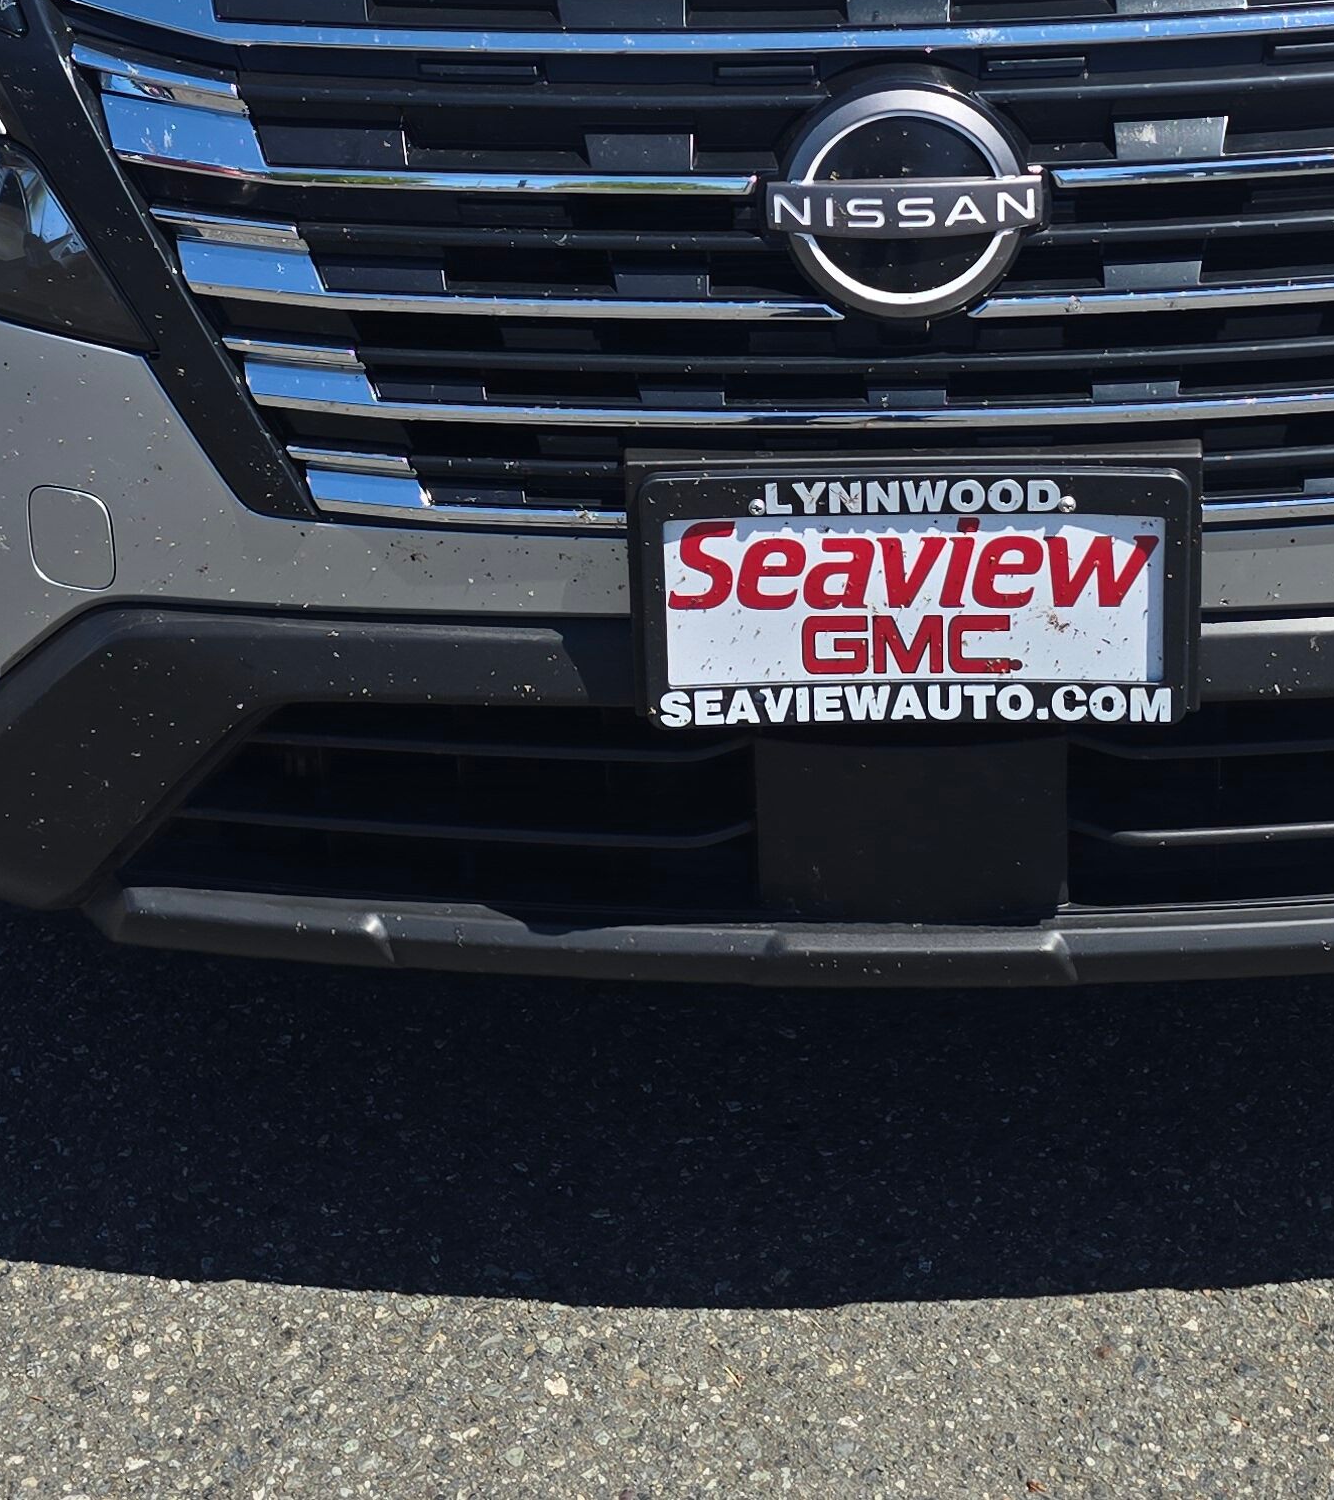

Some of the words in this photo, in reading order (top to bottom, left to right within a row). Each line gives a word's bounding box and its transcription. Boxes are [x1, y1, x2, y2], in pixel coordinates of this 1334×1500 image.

[773, 188, 1036, 228] NISSAN
[765, 478, 1062, 515] LYNNWOOD
[667, 517, 1159, 610] Seaview
[801, 615, 1013, 674] GMC
[659, 684, 1172, 728] SEAVIEWAUTO.COM
